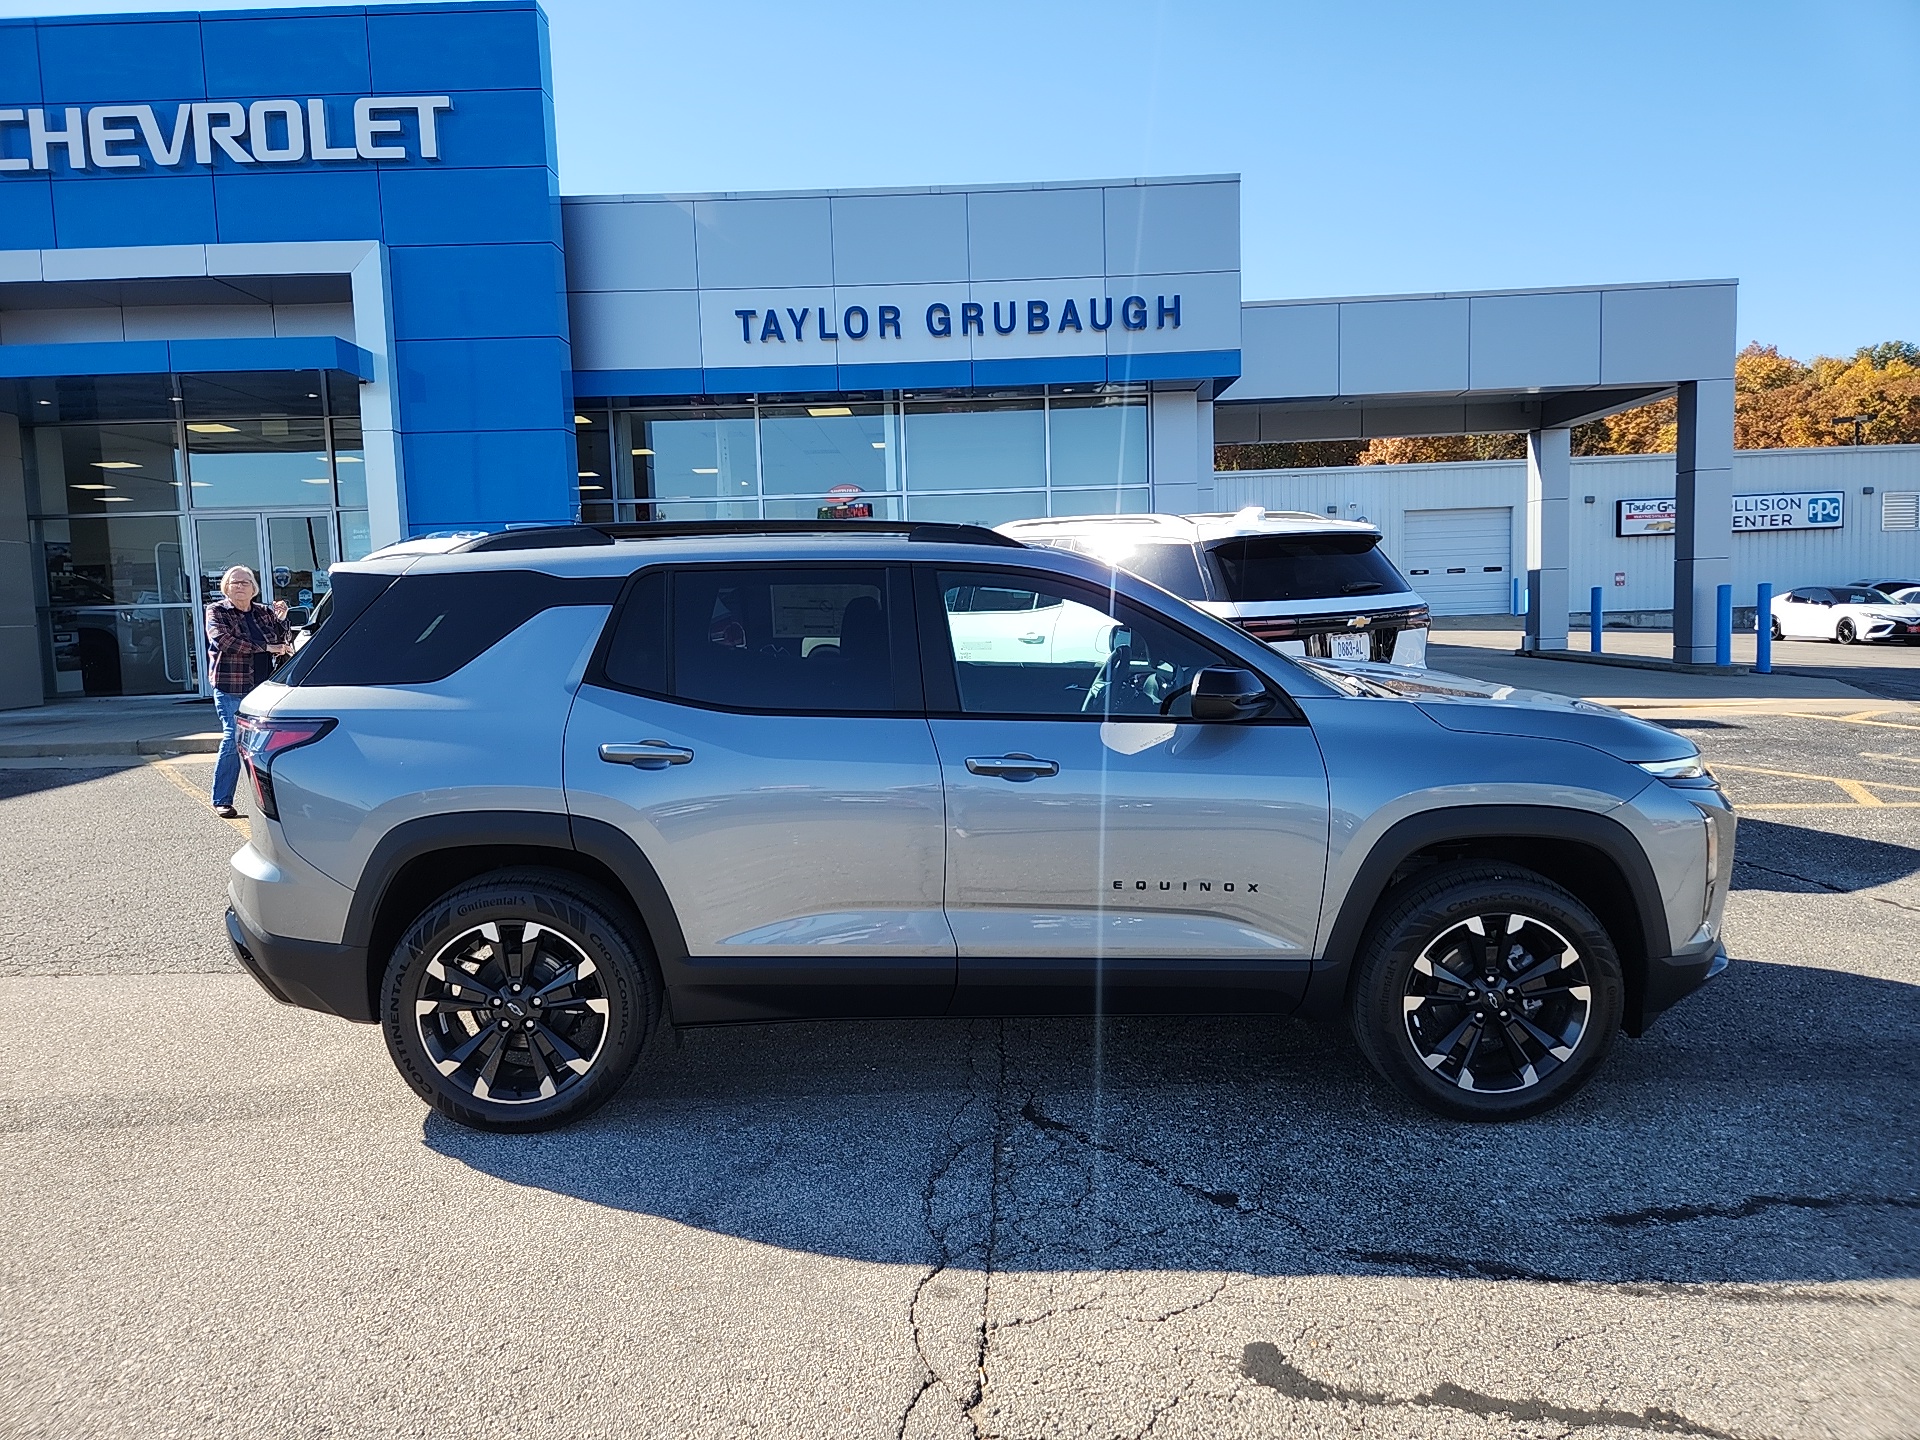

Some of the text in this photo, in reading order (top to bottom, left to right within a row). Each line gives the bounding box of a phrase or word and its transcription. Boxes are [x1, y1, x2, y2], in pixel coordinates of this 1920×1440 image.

[735, 295, 1182, 343] TAYLOR GRUBAUGH
[1625, 502, 1656, 513] Taylor
[1734, 497, 1802, 512] LLISION
[1808, 499, 1839, 522] PPG
[1732, 513, 1793, 528] ENTER
[1112, 880, 1259, 893] EQUINOX
[457, 896, 517, 916] Continental
[389, 960, 433, 1095] CONTINENTAL
